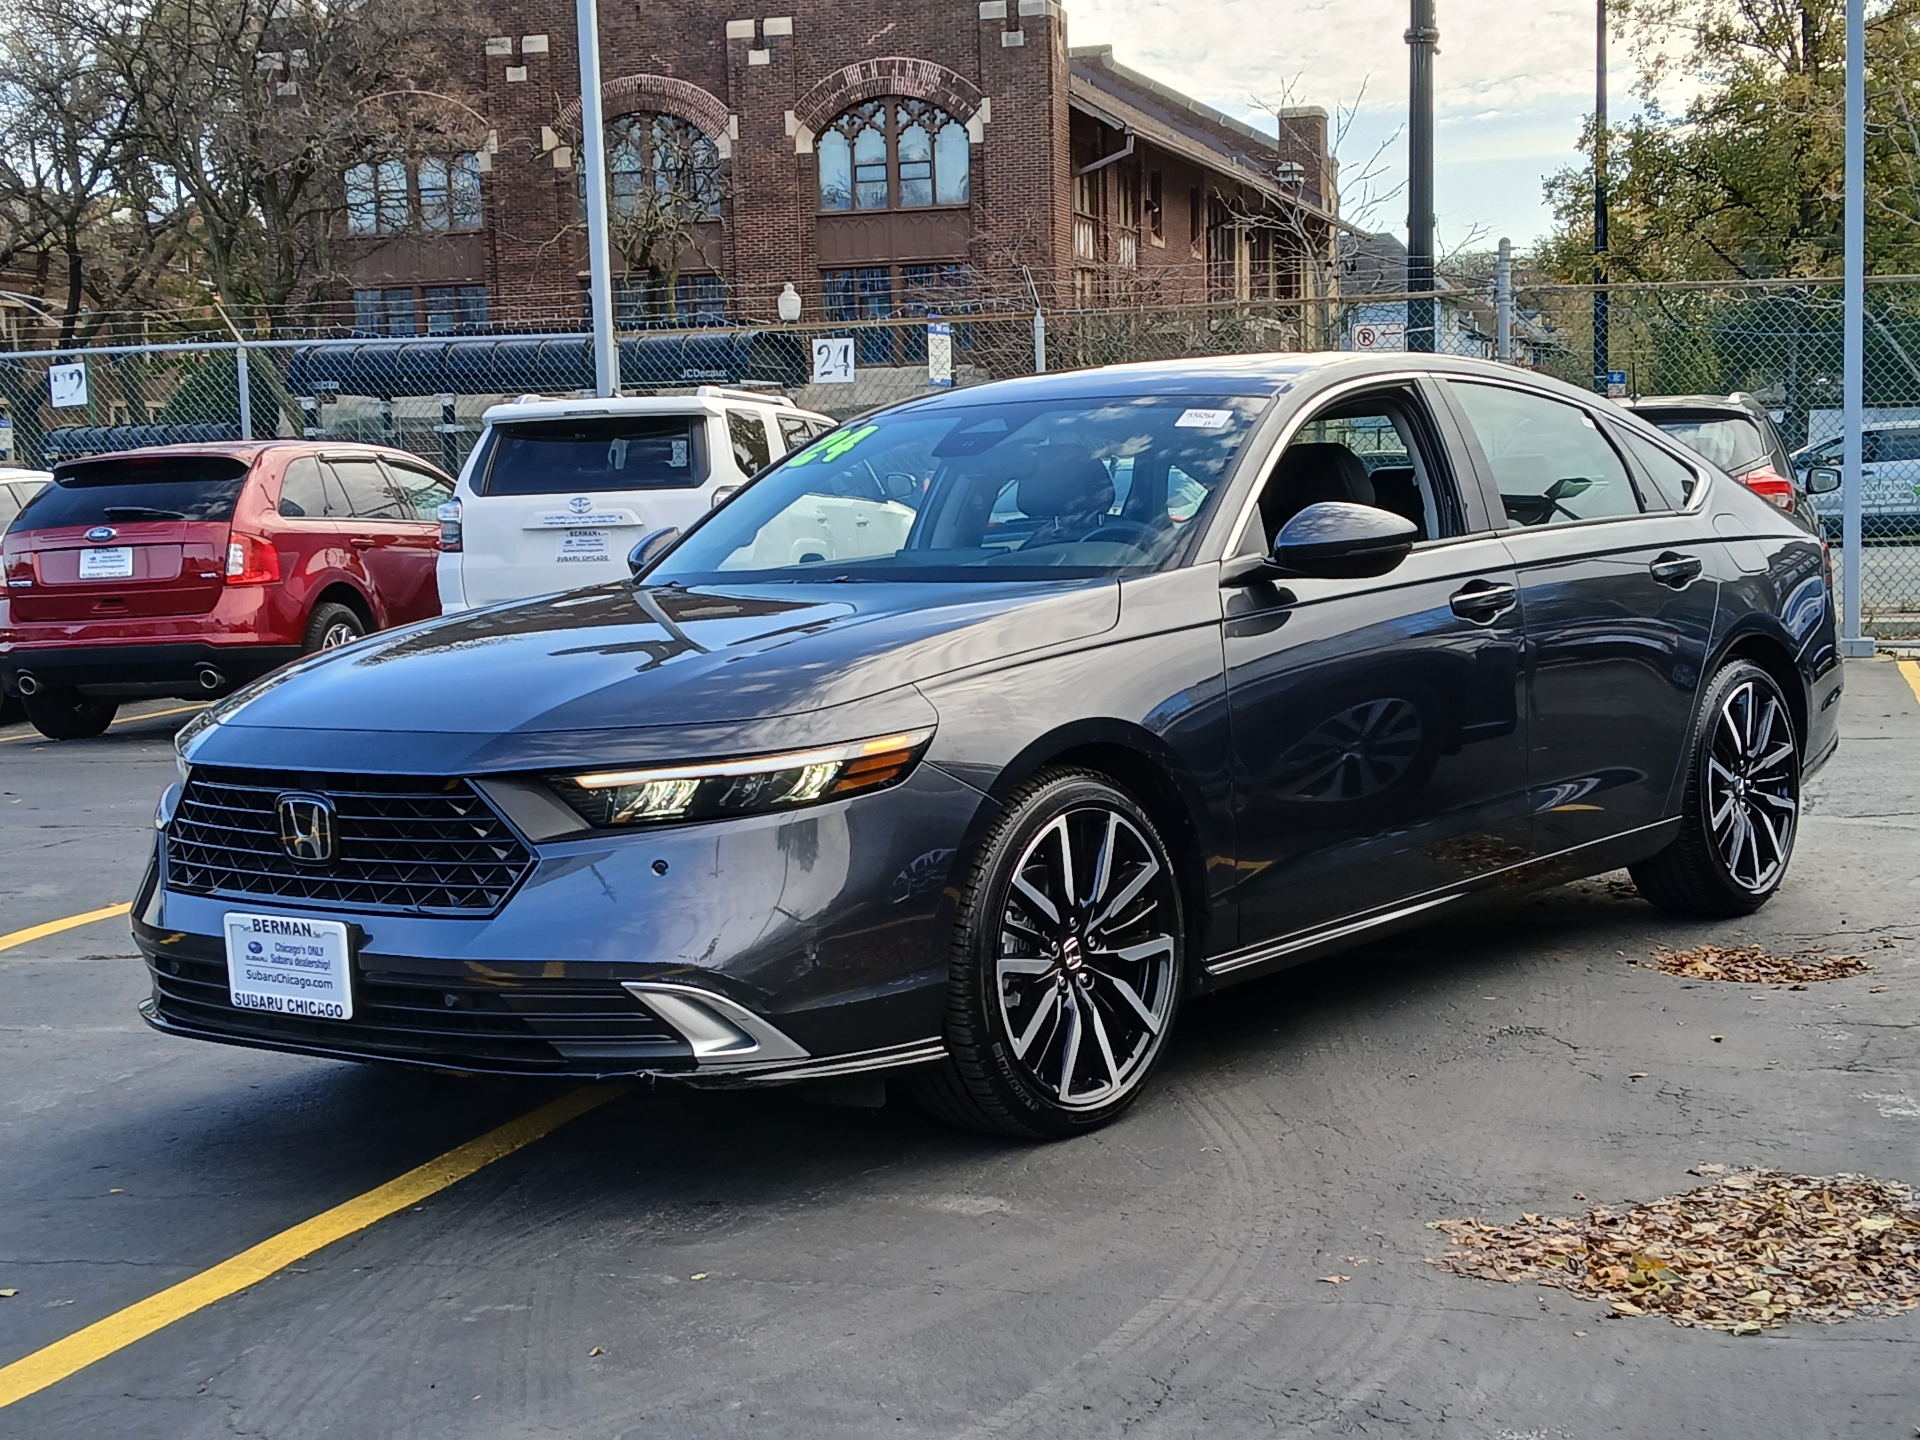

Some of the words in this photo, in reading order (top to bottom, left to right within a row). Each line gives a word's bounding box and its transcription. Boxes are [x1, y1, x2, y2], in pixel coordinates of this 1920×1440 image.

[817, 344, 850, 377] 24
[681, 368, 727, 379] JCDecaux
[252, 919, 312, 937] BERMAN
[274, 942, 306, 956] Chicago's
[308, 945, 324, 957] ONLY
[270, 954, 293, 966] Subaru
[295, 957, 331, 971] dealership!
[246, 969, 333, 990] SubaruChicago.com
[234, 992, 283, 1011] SUBARU
[287, 998, 343, 1018] CHICAGO
